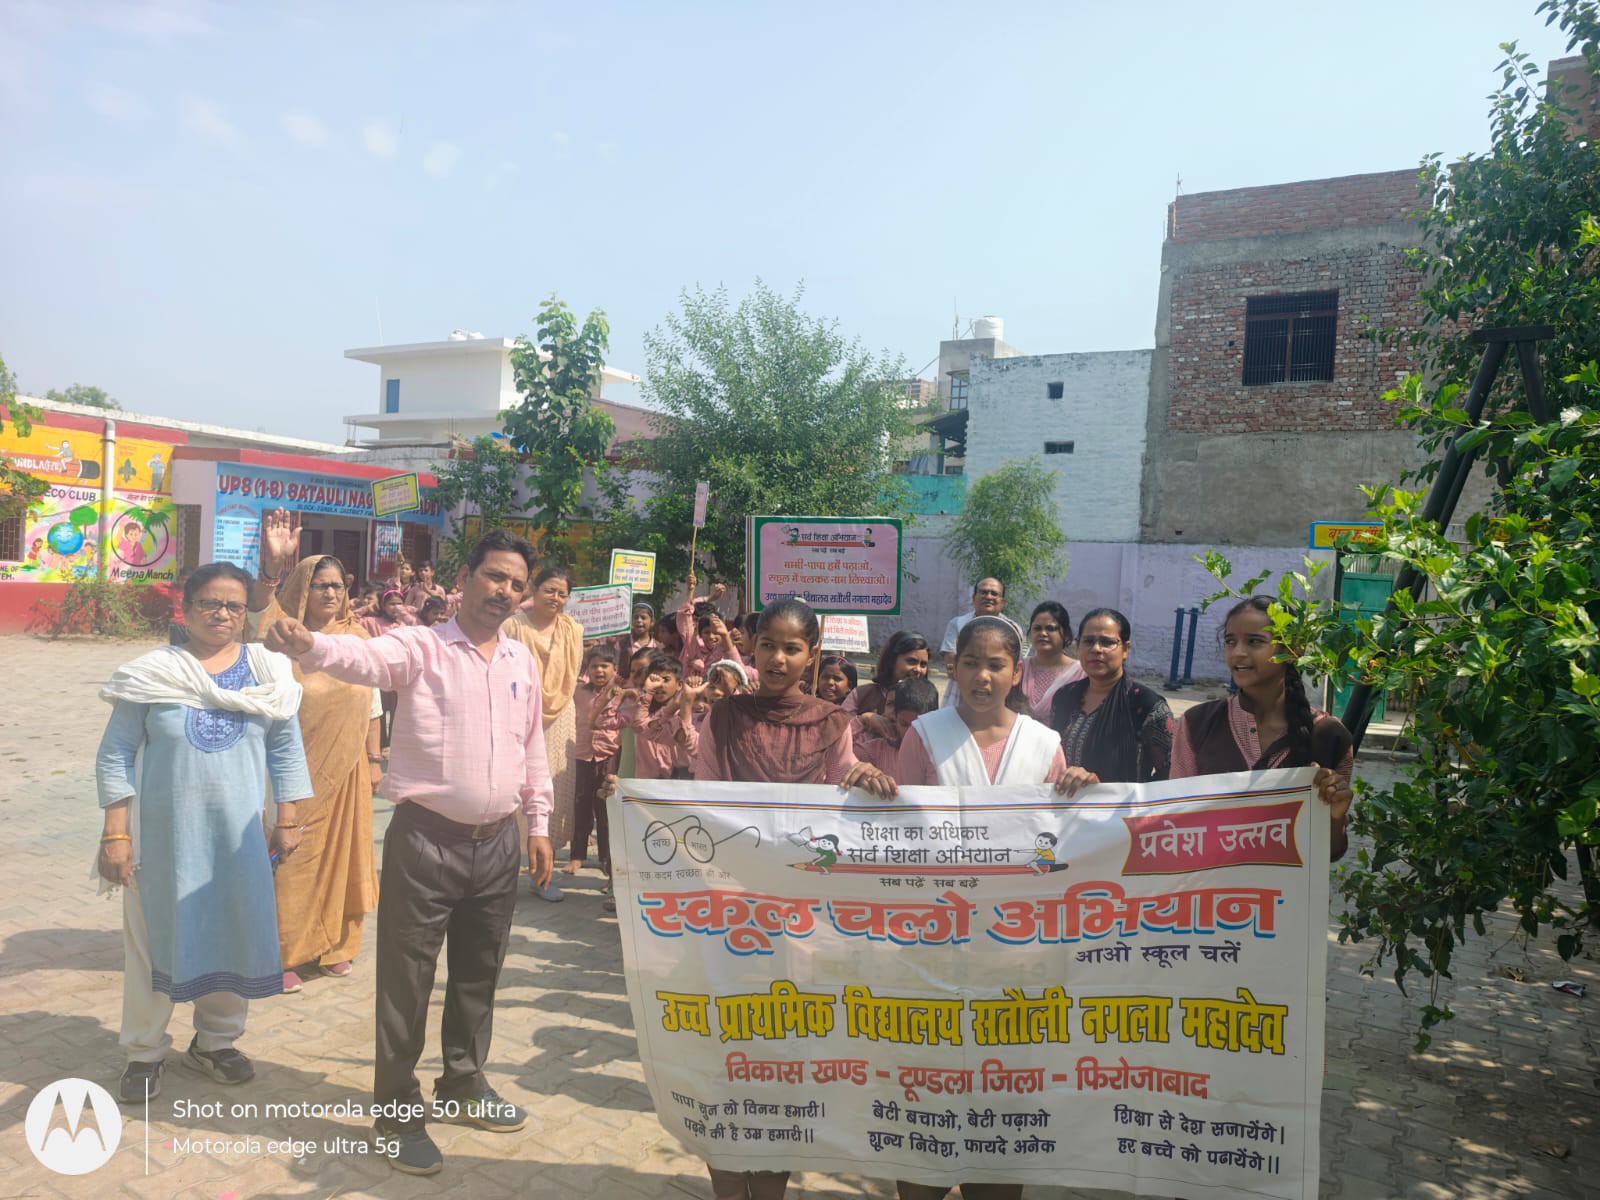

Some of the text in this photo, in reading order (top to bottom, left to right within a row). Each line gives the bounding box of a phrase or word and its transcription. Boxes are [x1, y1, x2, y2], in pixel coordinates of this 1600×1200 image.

[68, 489, 97, 501] CLUB
[110, 567, 174, 582] Meena Manch
[768, 574, 790, 585] स्कूल
[791, 571, 799, 584] में
[800, 575, 829, 584] चलकर
[831, 575, 847, 584] नाम
[861, 820, 990, 841] शिक्षा का अधिकार
[1139, 817, 1291, 859] प्रवेश उत्सव
[847, 845, 1013, 864] सर्व शिक्षा अभियान
[640, 871, 651, 880] एक
[654, 870, 672, 880] कदम
[676, 868, 702, 879] स्वच्छता
[879, 876, 980, 889] सब पढ़ें सब बढ़ें
[638, 880, 1284, 956] स्कूल चलो अभियान
[1076, 940, 1241, 968] आओ स्कूल चलें
[655, 980, 1288, 1055] उच्च प्राथमिक विद्यालय सतौली नगला महादेव
[726, 1052, 804, 1084] विकास
[810, 1059, 869, 1086] खण्ड
[897, 1064, 974, 1102] टूण्डला
[981, 1059, 1046, 1094] जिला
[1075, 1056, 1210, 1100] फिरोजाबाद
[670, 1090, 695, 1110] पापा
[698, 1101, 719, 1120] सुन
[723, 1099, 739, 1116] लो
[743, 1099, 780, 1116] विनय
[872, 1100, 1051, 1132] बेटी बचाओ, बेटी पढ़ाओ
[684, 1117, 707, 1138] पढ़ने
[710, 1123, 726, 1140] की
[729, 1121, 740, 1141] है
[1114, 1104, 1154, 1127] शिक्षा
[1159, 1109, 1174, 1131] से
[1179, 1112, 1206, 1135] देश
[867, 1130, 1057, 1158] शून्य निवेश, फायदे अनेक
[1117, 1137, 1136, 1154] हर
[1141, 1140, 1175, 1160] बच्चे
[1181, 1143, 1202, 1163] को
